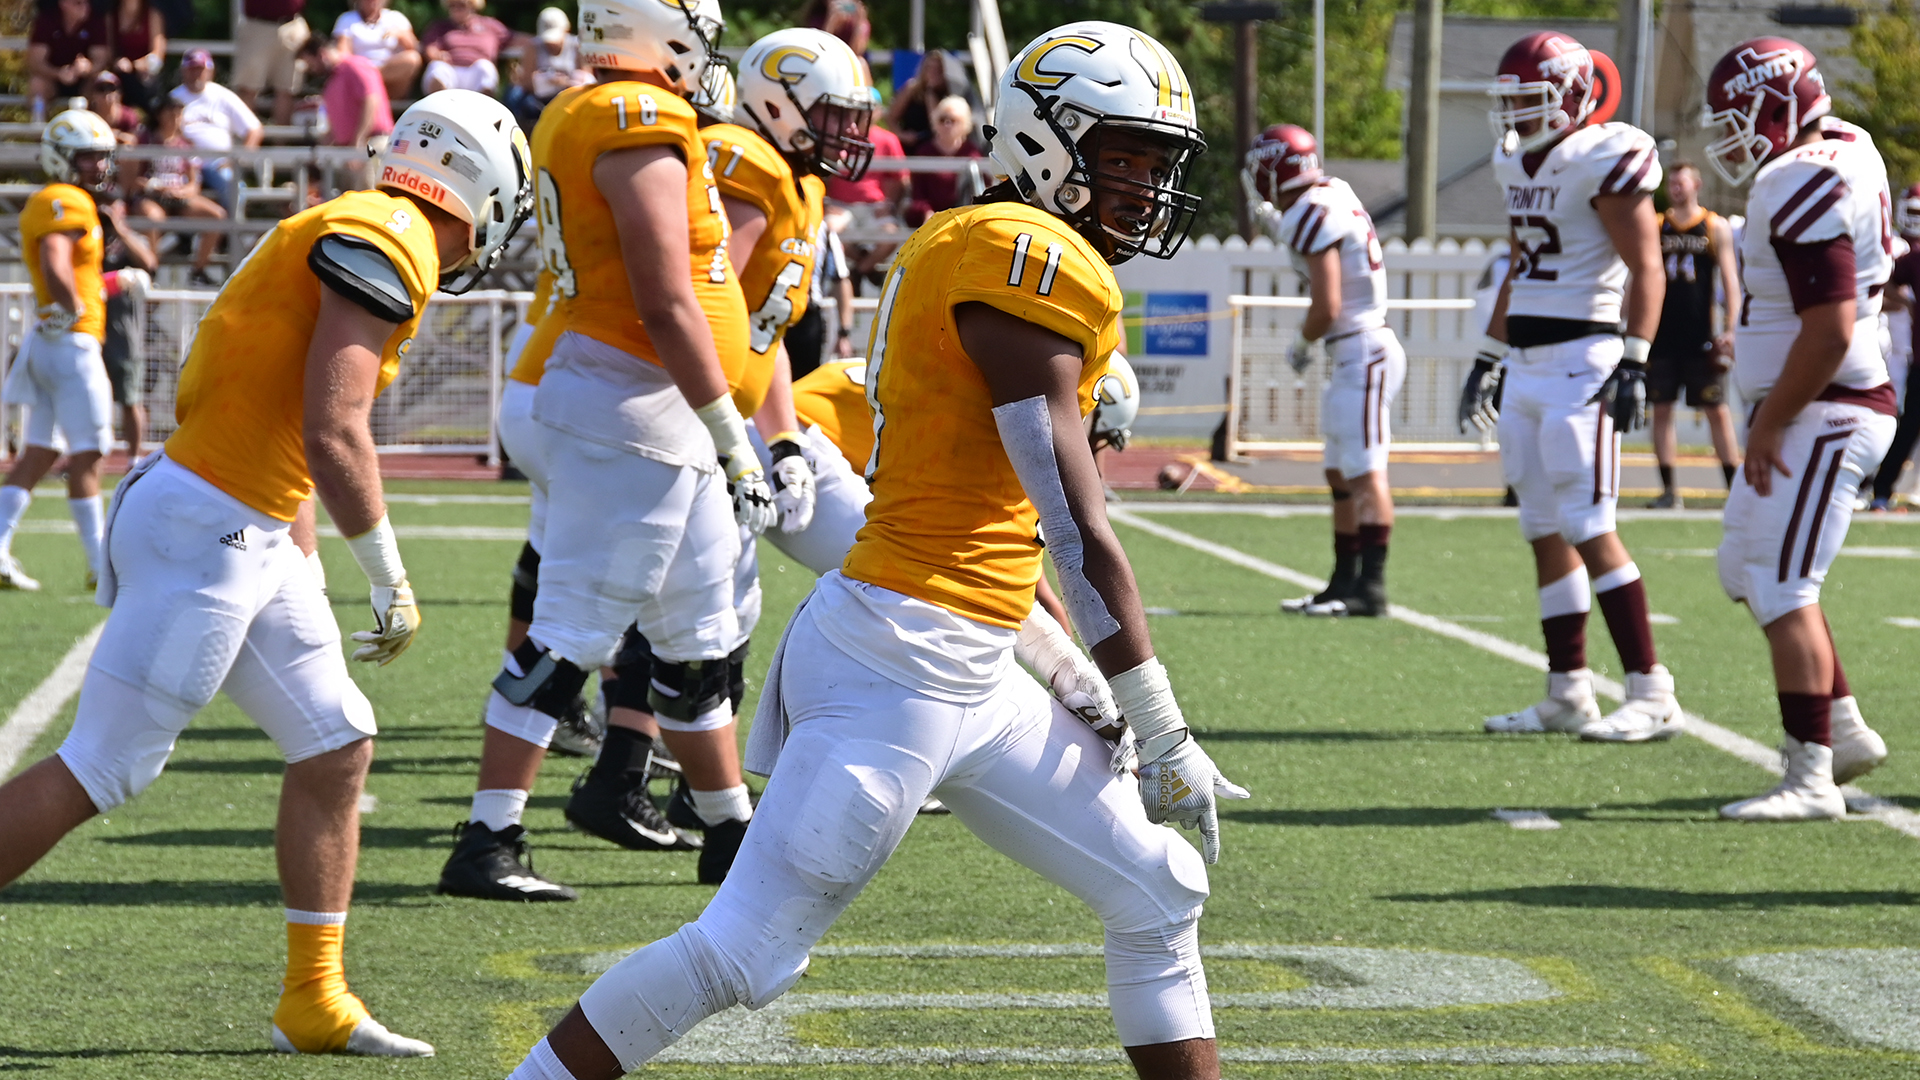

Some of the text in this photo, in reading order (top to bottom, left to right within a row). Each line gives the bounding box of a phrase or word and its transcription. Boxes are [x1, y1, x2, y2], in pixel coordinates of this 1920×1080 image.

[1015, 35, 1106, 91] C
[382, 166, 447, 204] Riddell
[1508, 185, 1561, 210] TRINITY
[1006, 232, 1064, 297] 11
[1159, 763, 1170, 811] adidas
